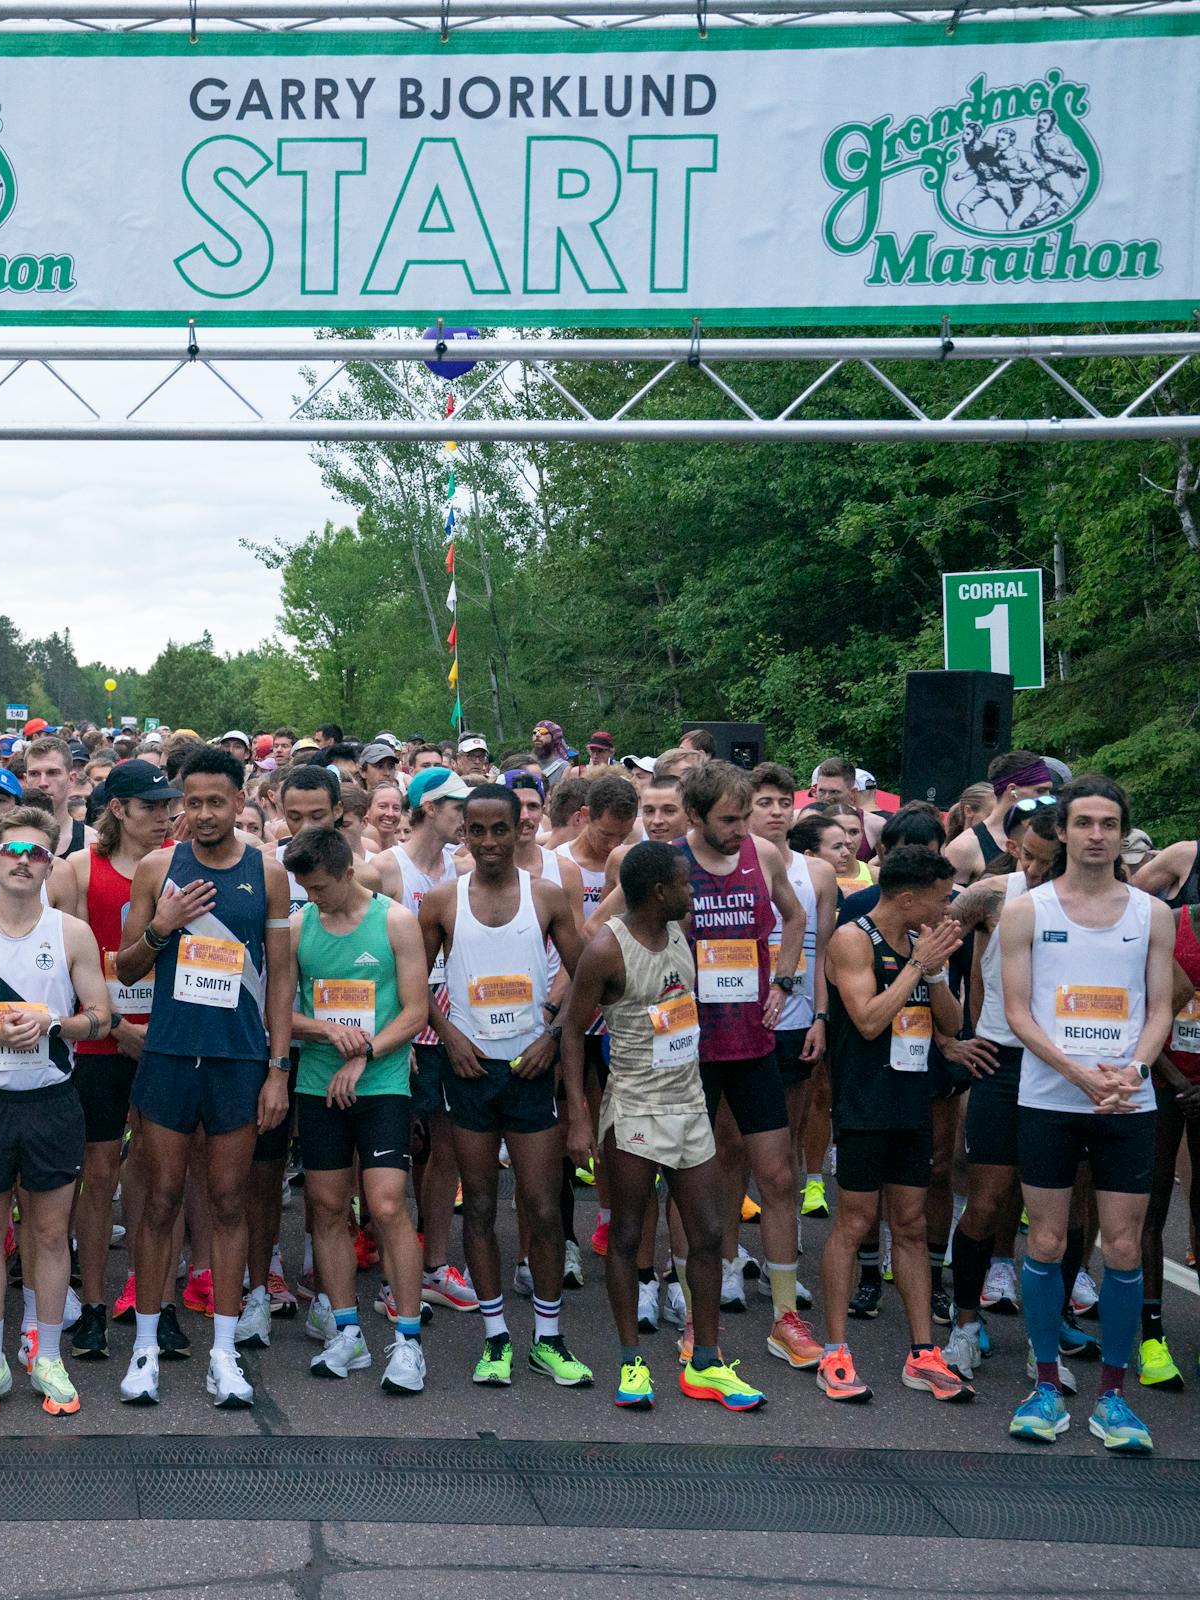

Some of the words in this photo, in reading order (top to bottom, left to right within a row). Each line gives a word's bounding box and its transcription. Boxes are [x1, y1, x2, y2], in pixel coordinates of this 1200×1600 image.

[189, 77, 377, 121] GARRY
[399, 73, 718, 121] BJORKLUND
[173, 133, 719, 299] START
[864, 221, 1164, 287] Marathon
[958, 581, 1028, 601] CORRAL
[974, 604, 1010, 675] 1
[10, 710, 23, 718] 1:40
[695, 911, 755, 928] RUNNING
[184, 974, 192, 986] T.
[196, 976, 232, 992] SMITH
[717, 975, 744, 988] RECK
[118, 987, 153, 1000] ALTIER
[490, 1012, 515, 1025] BATI
[1065, 1026, 1121, 1040] REICHOW
[669, 1035, 694, 1052] KORIR
